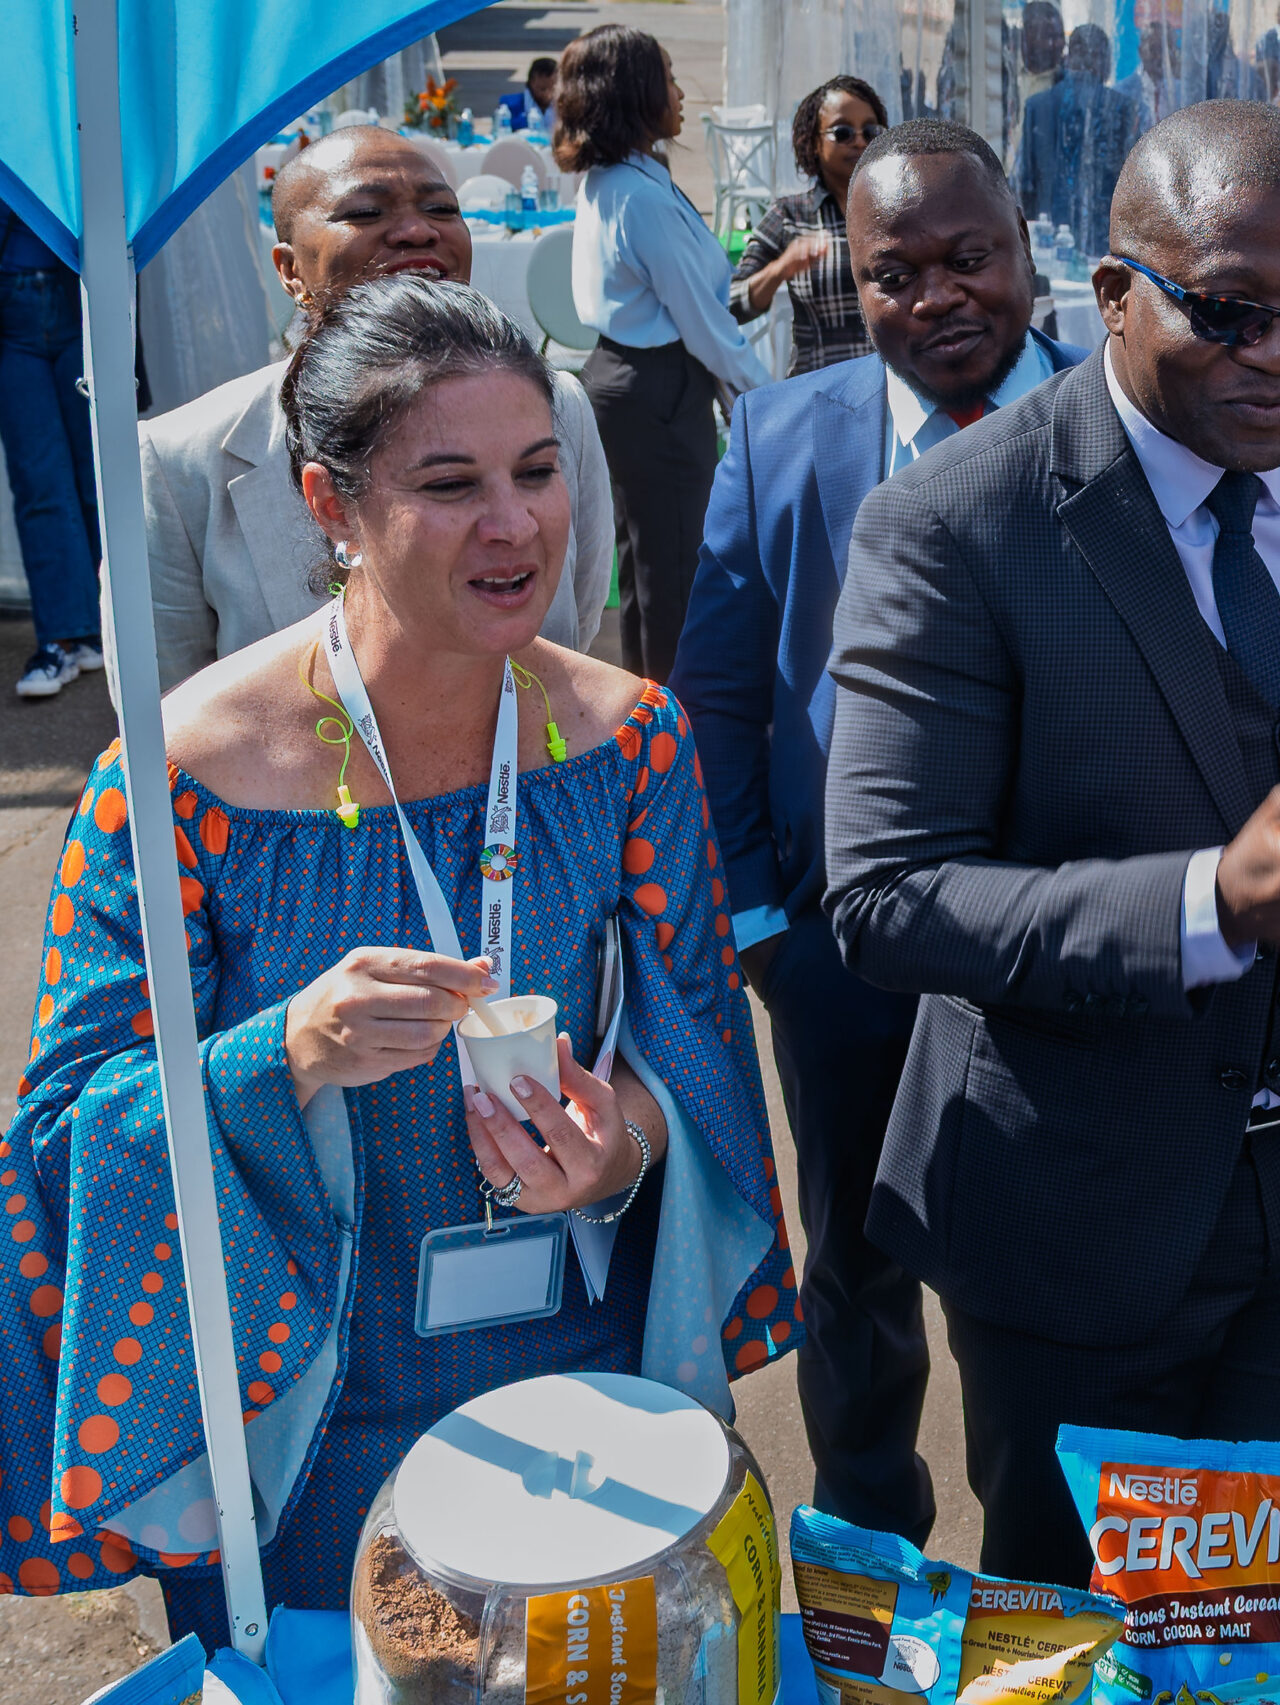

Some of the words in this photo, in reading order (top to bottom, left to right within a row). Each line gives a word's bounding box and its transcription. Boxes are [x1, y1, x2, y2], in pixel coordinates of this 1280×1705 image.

[743, 1534, 764, 1592] CORN
[970, 1588, 1064, 1612] CEREVITA
[1170, 1601, 1231, 1621] Instant
[566, 1594, 590, 1662] CORN
[608, 1589, 628, 1666] Instant
[1125, 1628, 1161, 1646] CORN,
[1163, 1624, 1202, 1640] COCOA
[1205, 1625, 1216, 1638] &
[1219, 1622, 1252, 1639] MALT
[566, 1670, 589, 1687] &
